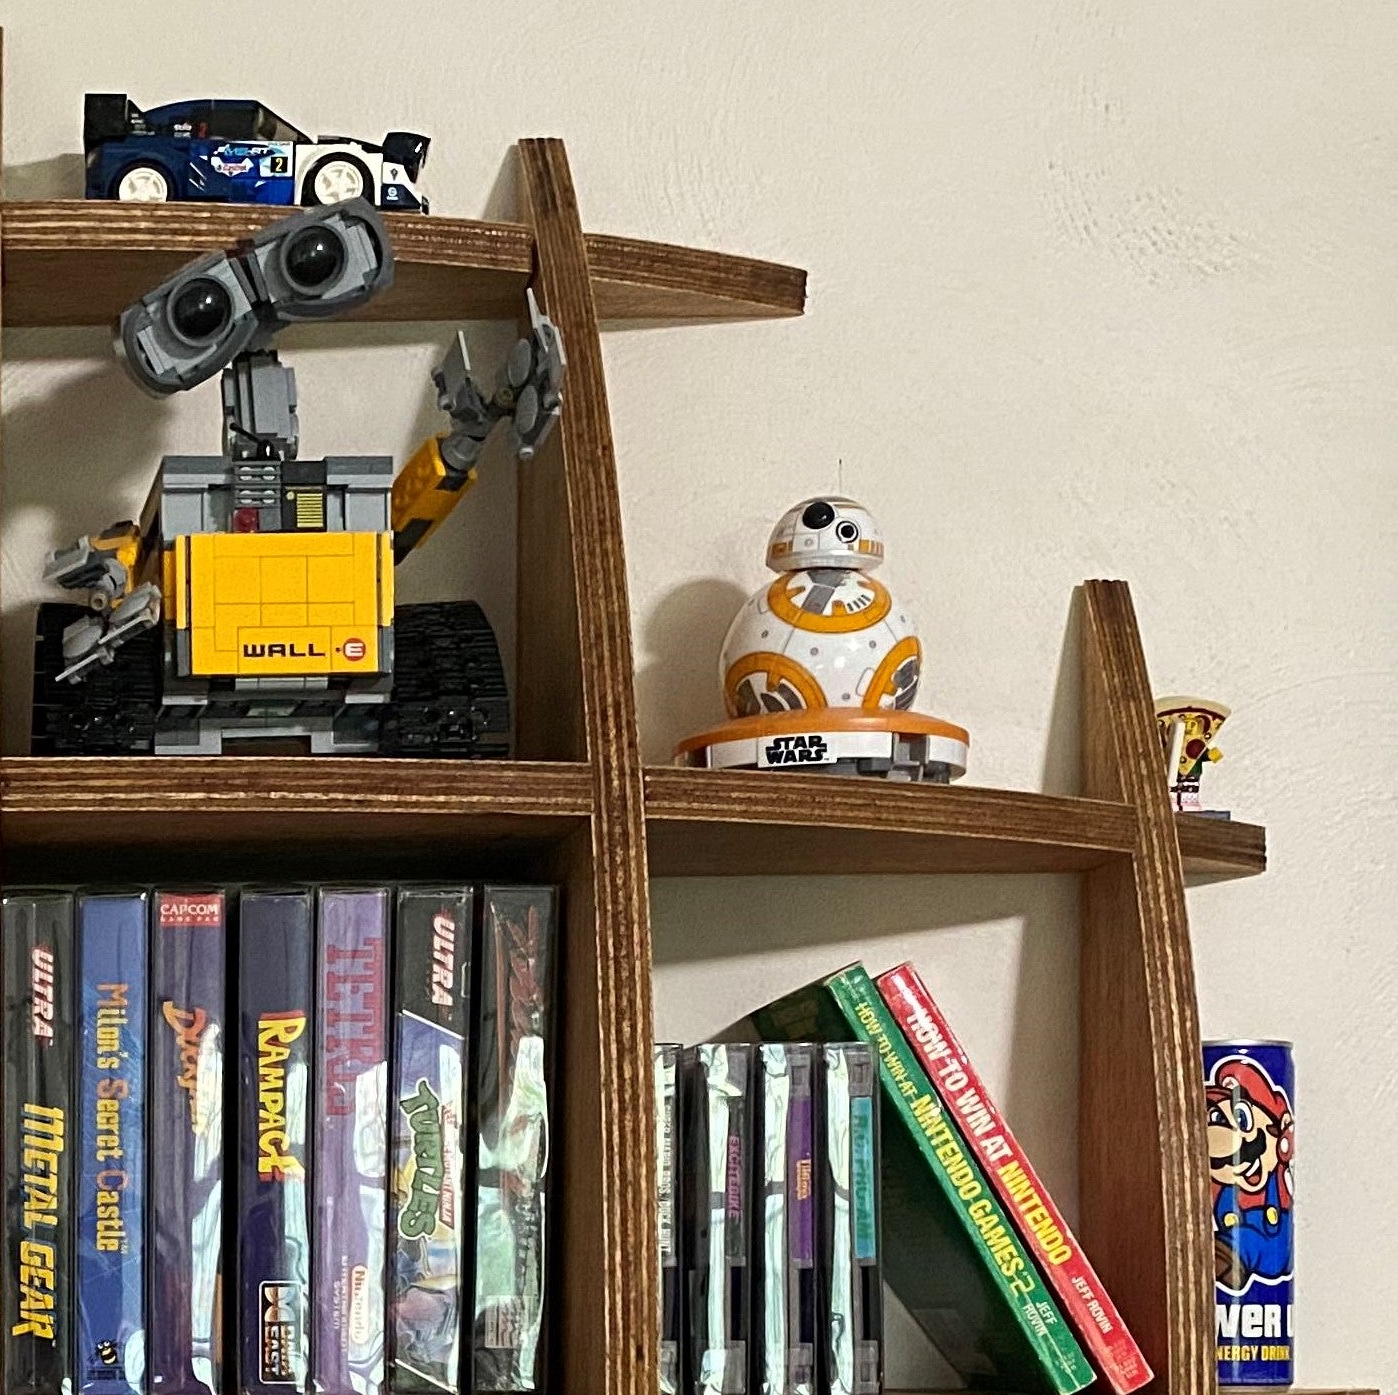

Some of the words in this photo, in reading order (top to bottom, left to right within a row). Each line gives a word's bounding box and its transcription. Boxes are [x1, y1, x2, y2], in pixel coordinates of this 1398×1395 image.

[275, 158, 283, 171] 2
[765, 747, 826, 765] WARS
[772, 736, 824, 750] STAR
[160, 904, 219, 915] CAPCOM
[31, 948, 54, 1041] ULTRA
[432, 915, 455, 1008] ULTRA
[96, 983, 129, 1069] Milon's
[96, 1077, 128, 1161] Secret
[402, 1081, 440, 1239] TURTLES
[937, 1056, 969, 1092] TO
[955, 1087, 996, 1137] WIN
[980, 1134, 1014, 1162] AT
[997, 1158, 1073, 1265] NINTENDO
[23, 1102, 65, 1231] METAL
[728, 1136, 741, 1219] EXCITEBIKE
[96, 1168, 128, 1251] Castle
[968, 1200, 1026, 1284] GAMES
[11, 1241, 57, 1341] GEAR
